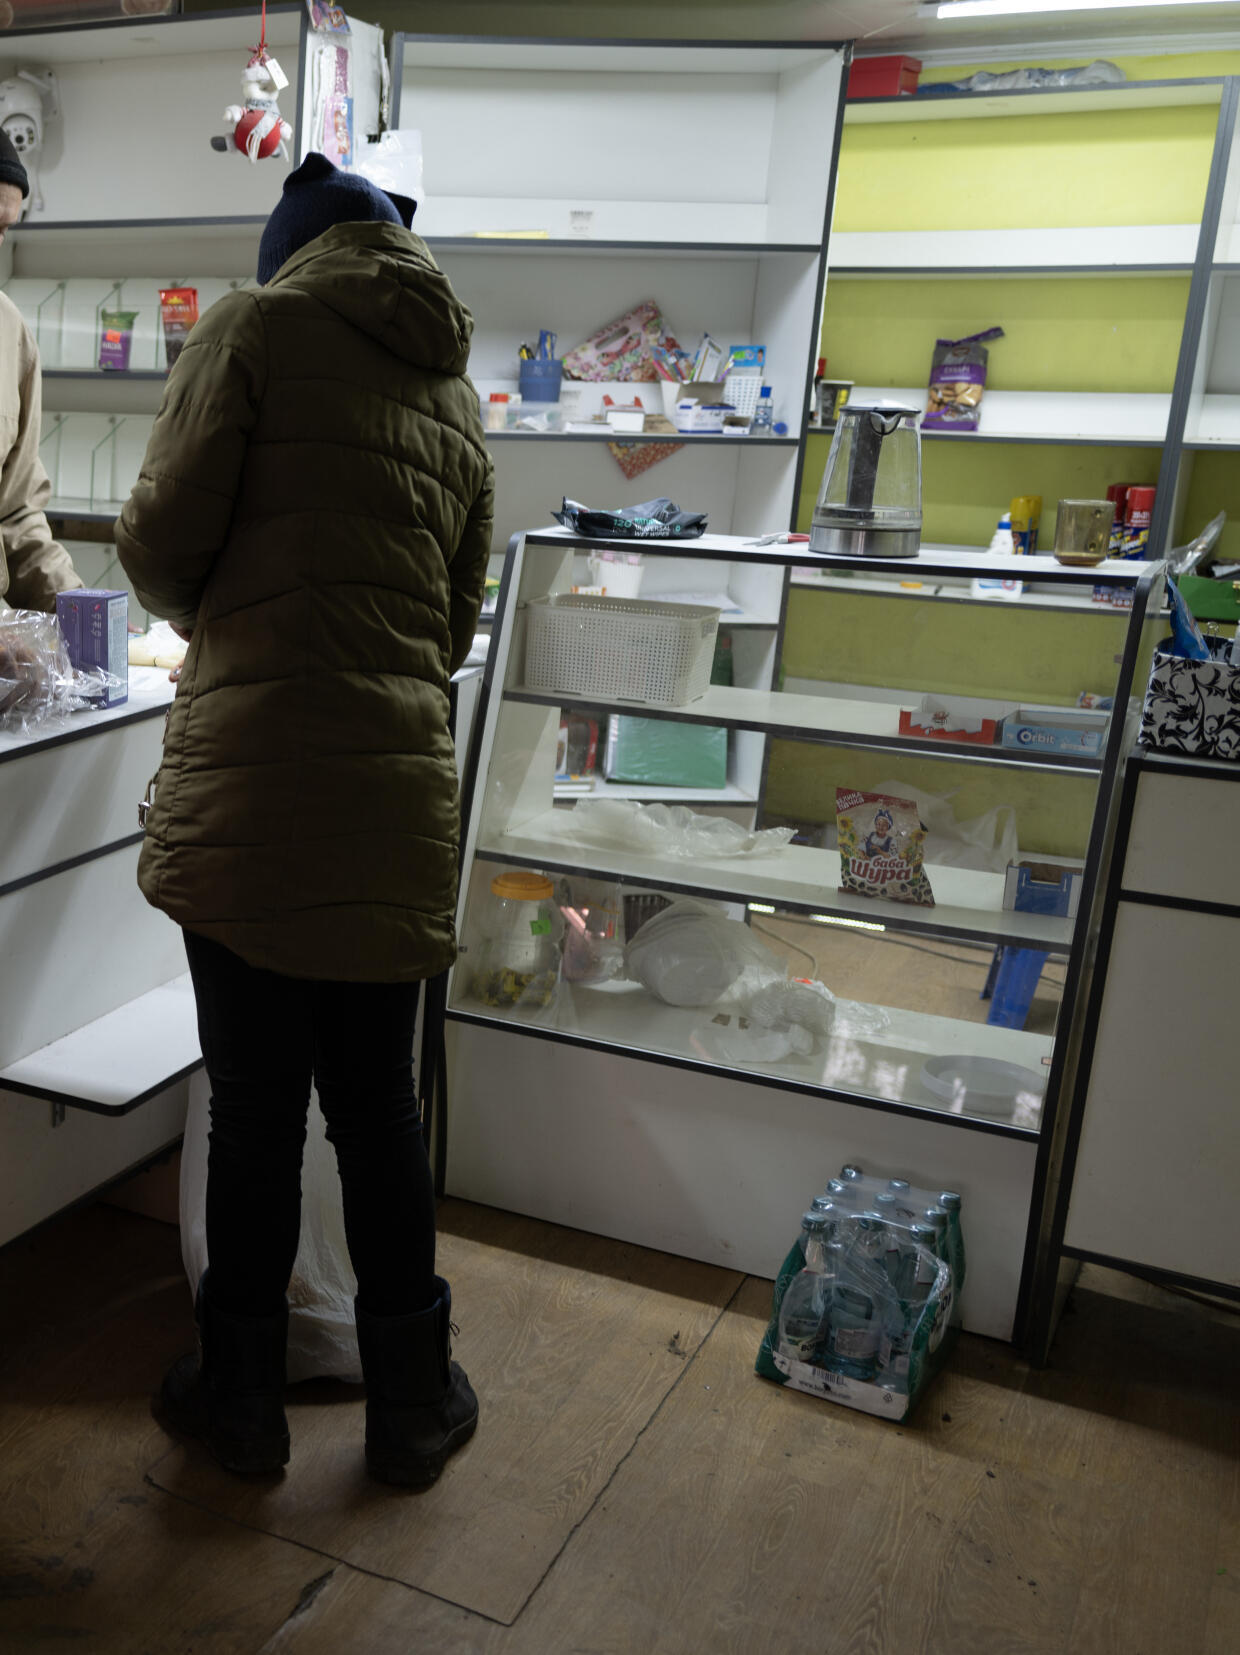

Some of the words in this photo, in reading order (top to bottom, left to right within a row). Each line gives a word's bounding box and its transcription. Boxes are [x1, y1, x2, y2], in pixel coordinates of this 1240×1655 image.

[1017, 727, 1056, 745] Orbit
[850, 858, 912, 885] Шура
[872, 857, 905, 869] баба
